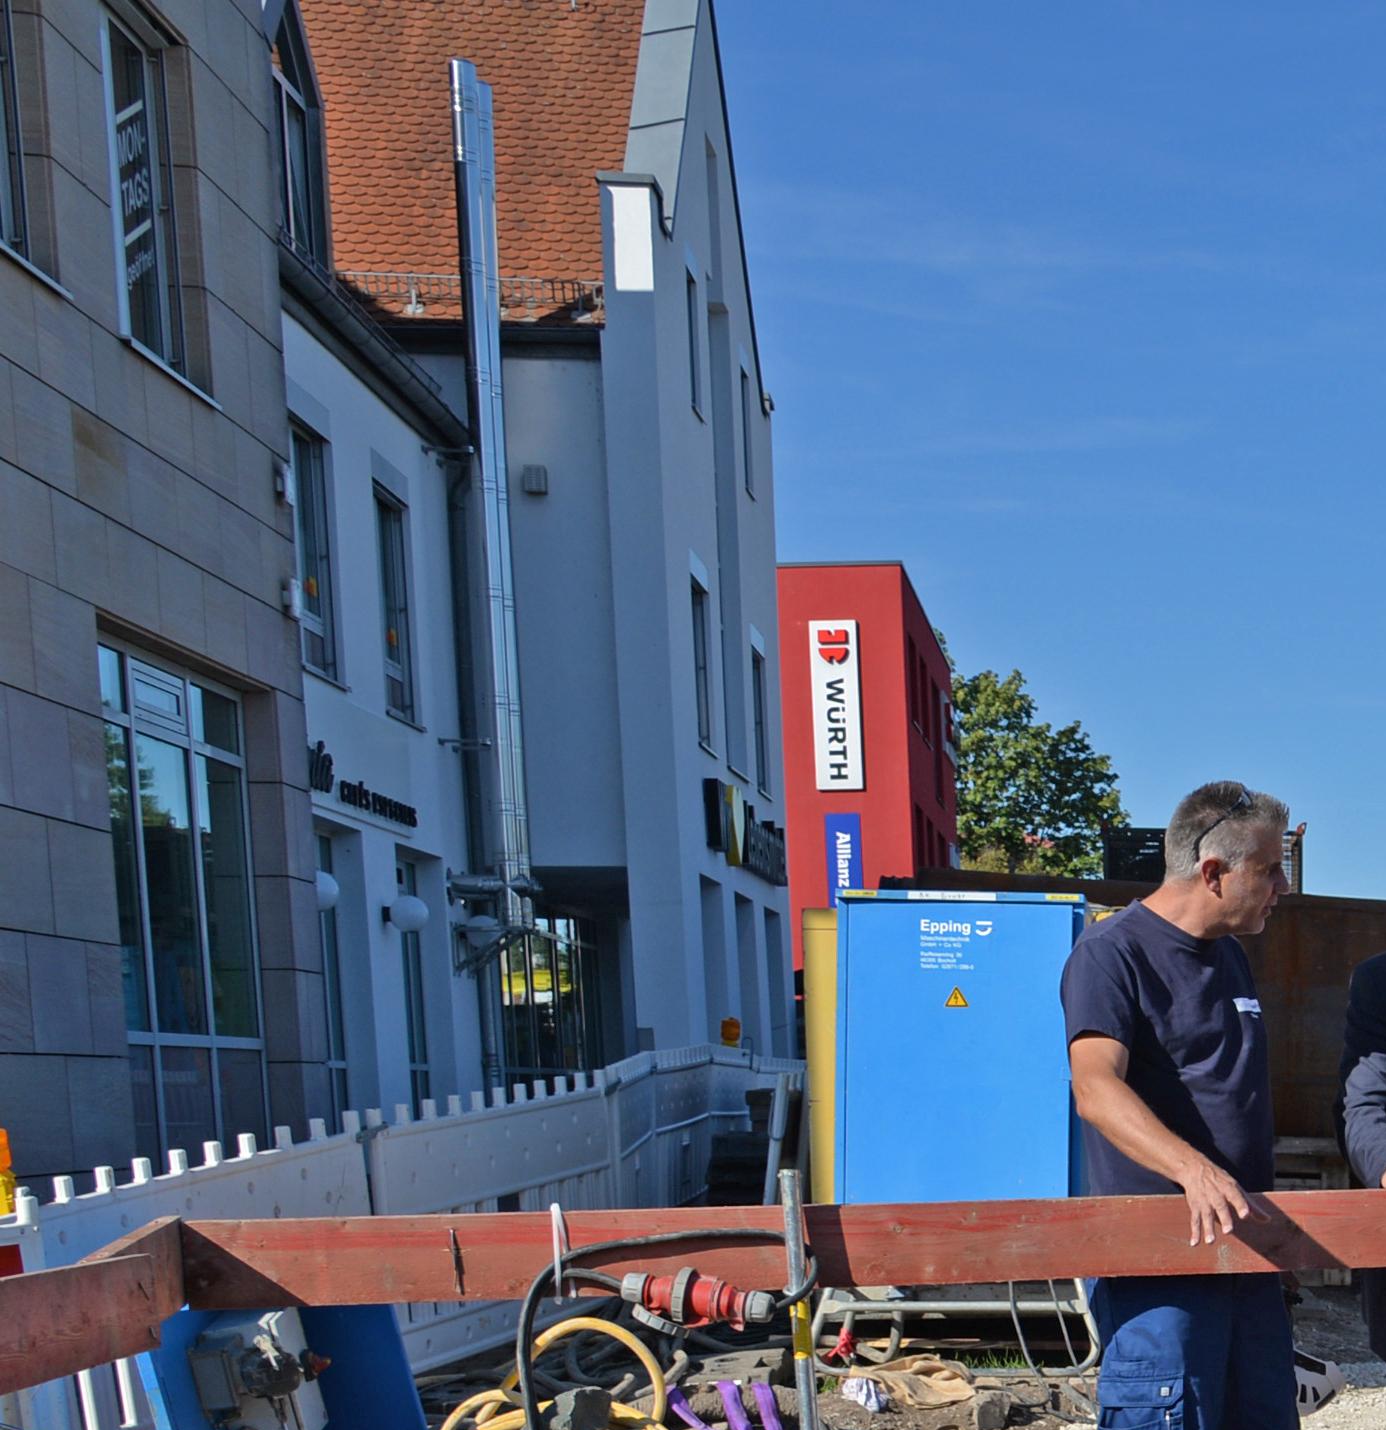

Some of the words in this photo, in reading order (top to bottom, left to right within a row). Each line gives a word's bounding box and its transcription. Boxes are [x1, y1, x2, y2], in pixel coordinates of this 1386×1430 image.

[121, 167, 150, 216] TAGS
[825, 677, 849, 781] WÜRTH
[835, 831, 850, 888] Allianz
[920, 919, 971, 935] Epping
